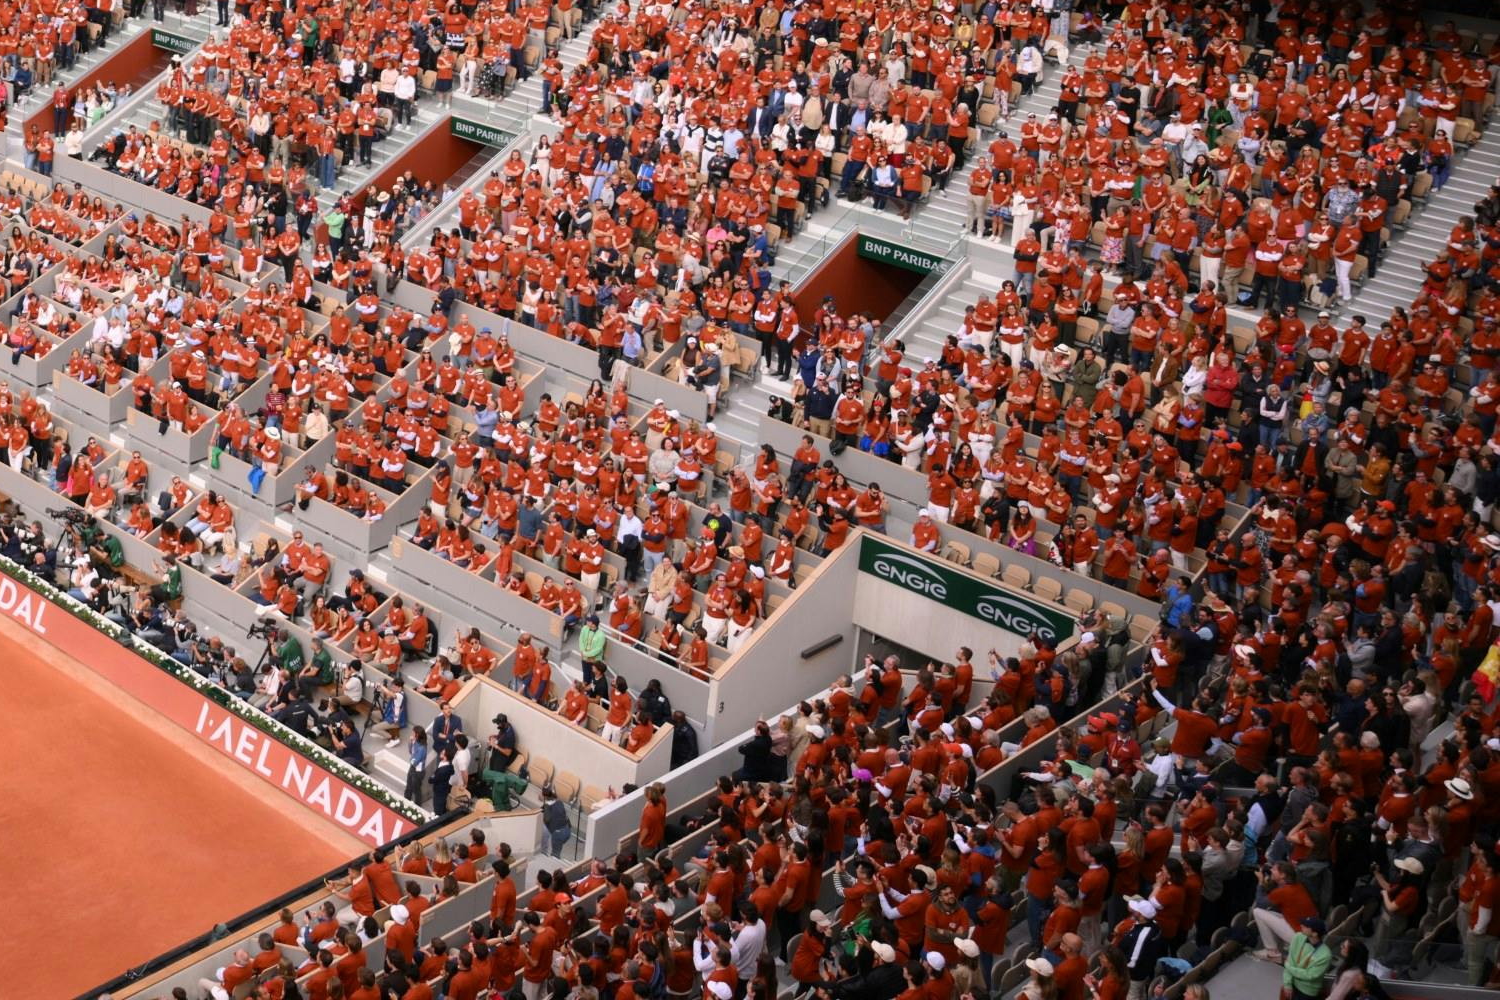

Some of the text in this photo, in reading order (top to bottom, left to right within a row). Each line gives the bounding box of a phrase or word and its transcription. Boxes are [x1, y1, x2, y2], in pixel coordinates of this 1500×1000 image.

[455, 122, 475, 134] BNP
[864, 240, 948, 274] BNP PARIBAS
